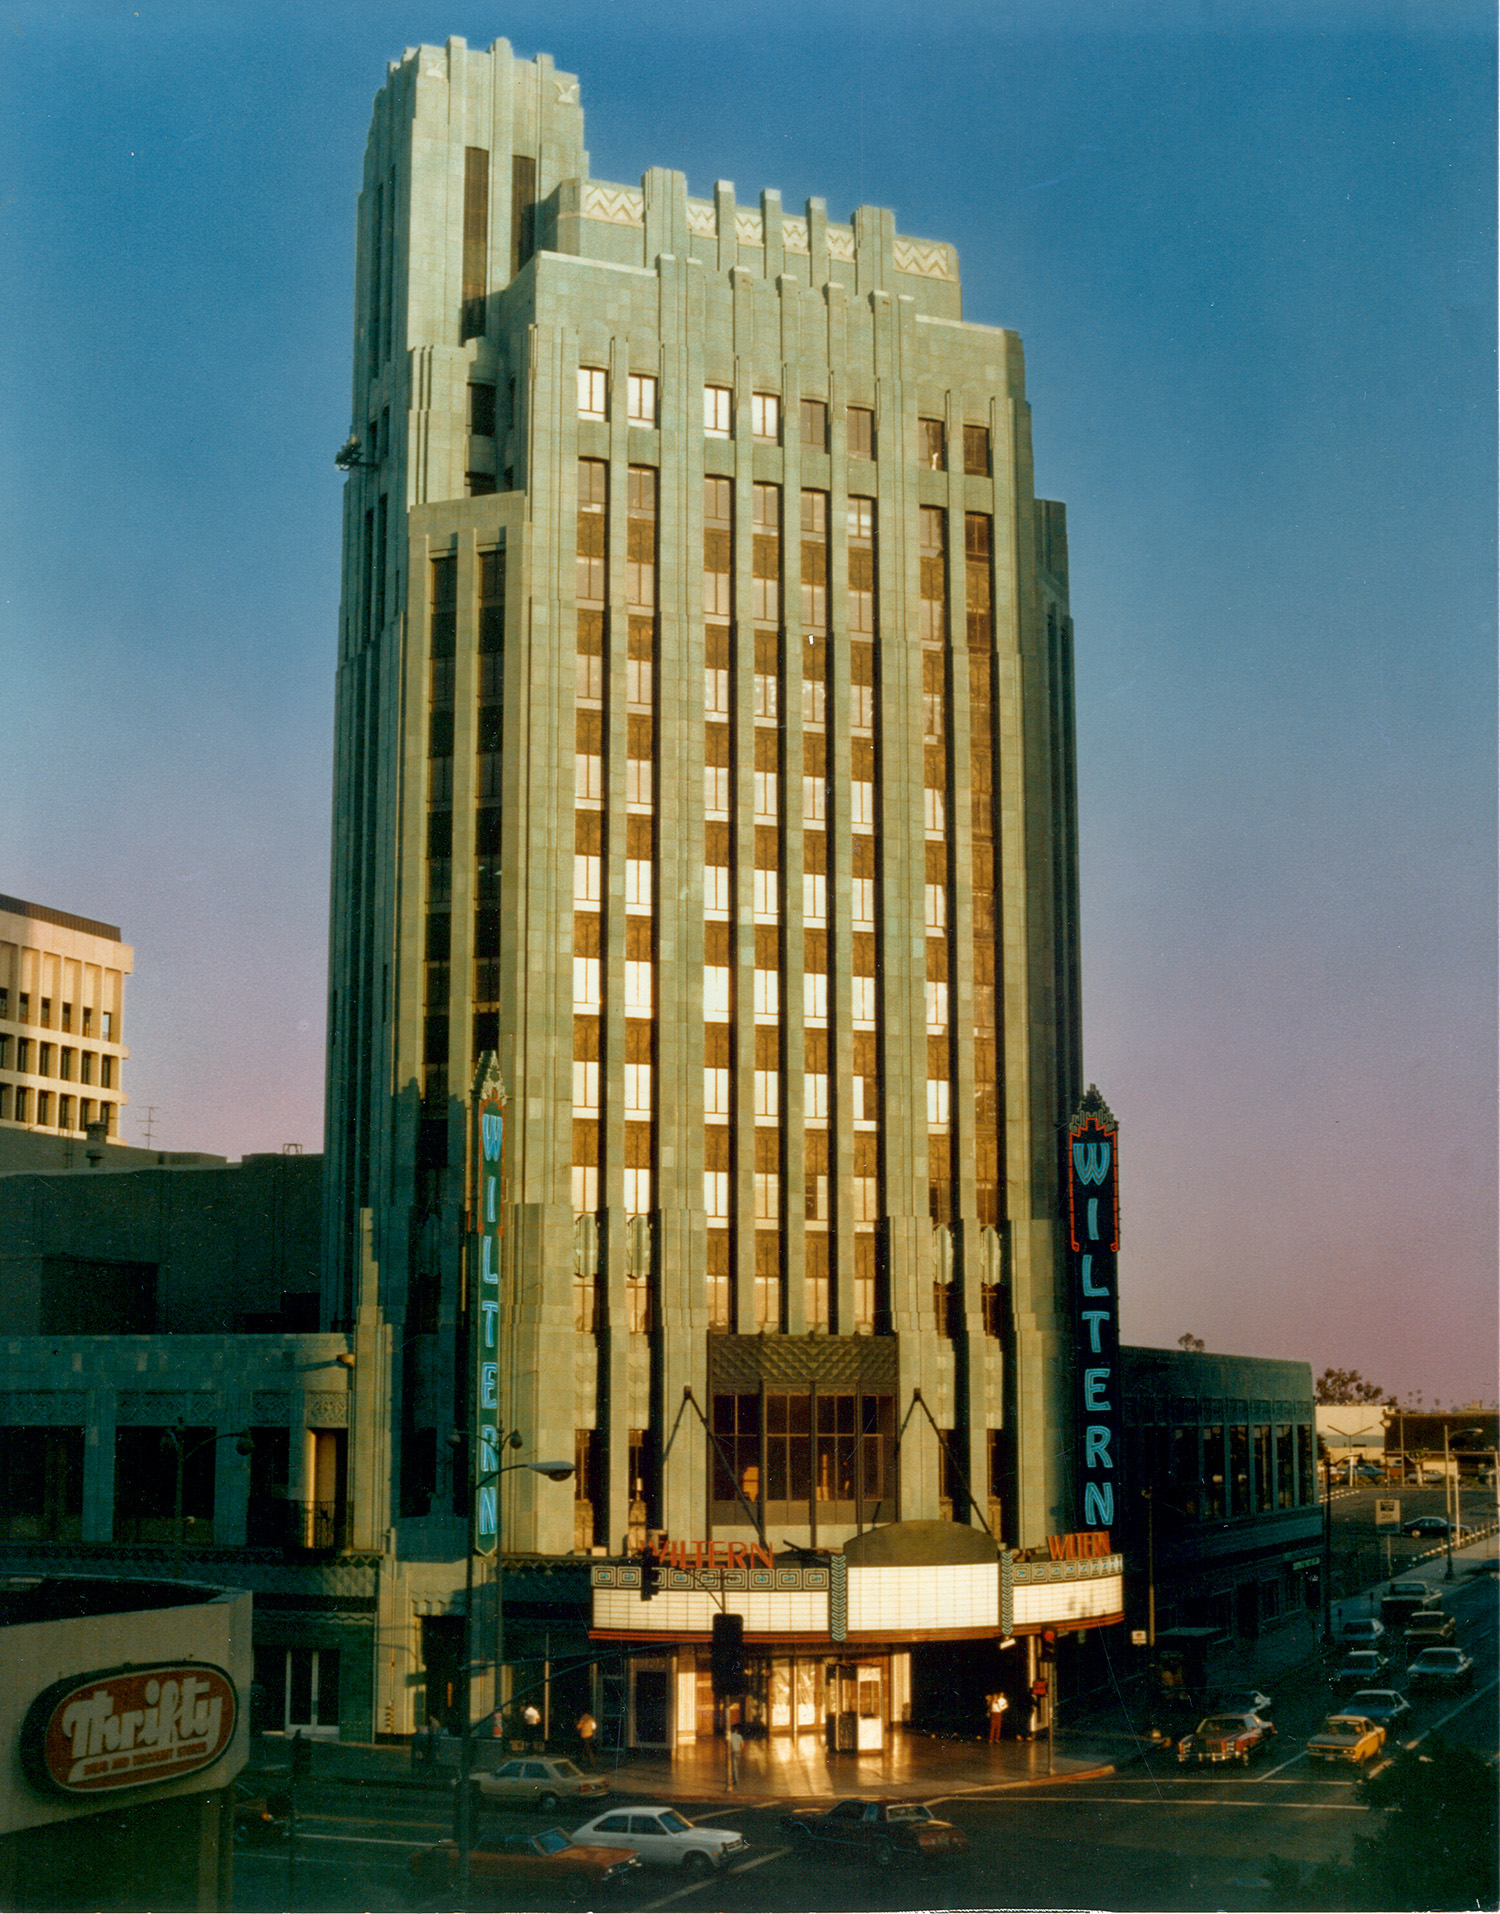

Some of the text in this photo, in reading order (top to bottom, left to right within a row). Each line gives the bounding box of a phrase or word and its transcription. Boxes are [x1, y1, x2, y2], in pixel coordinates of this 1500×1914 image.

[480, 1113, 502, 1534] WILTERN
[1072, 1142, 1114, 1526] WILTERN
[1047, 1531, 1111, 1561] WILTERN
[62, 1676, 223, 1759] Thrifty
